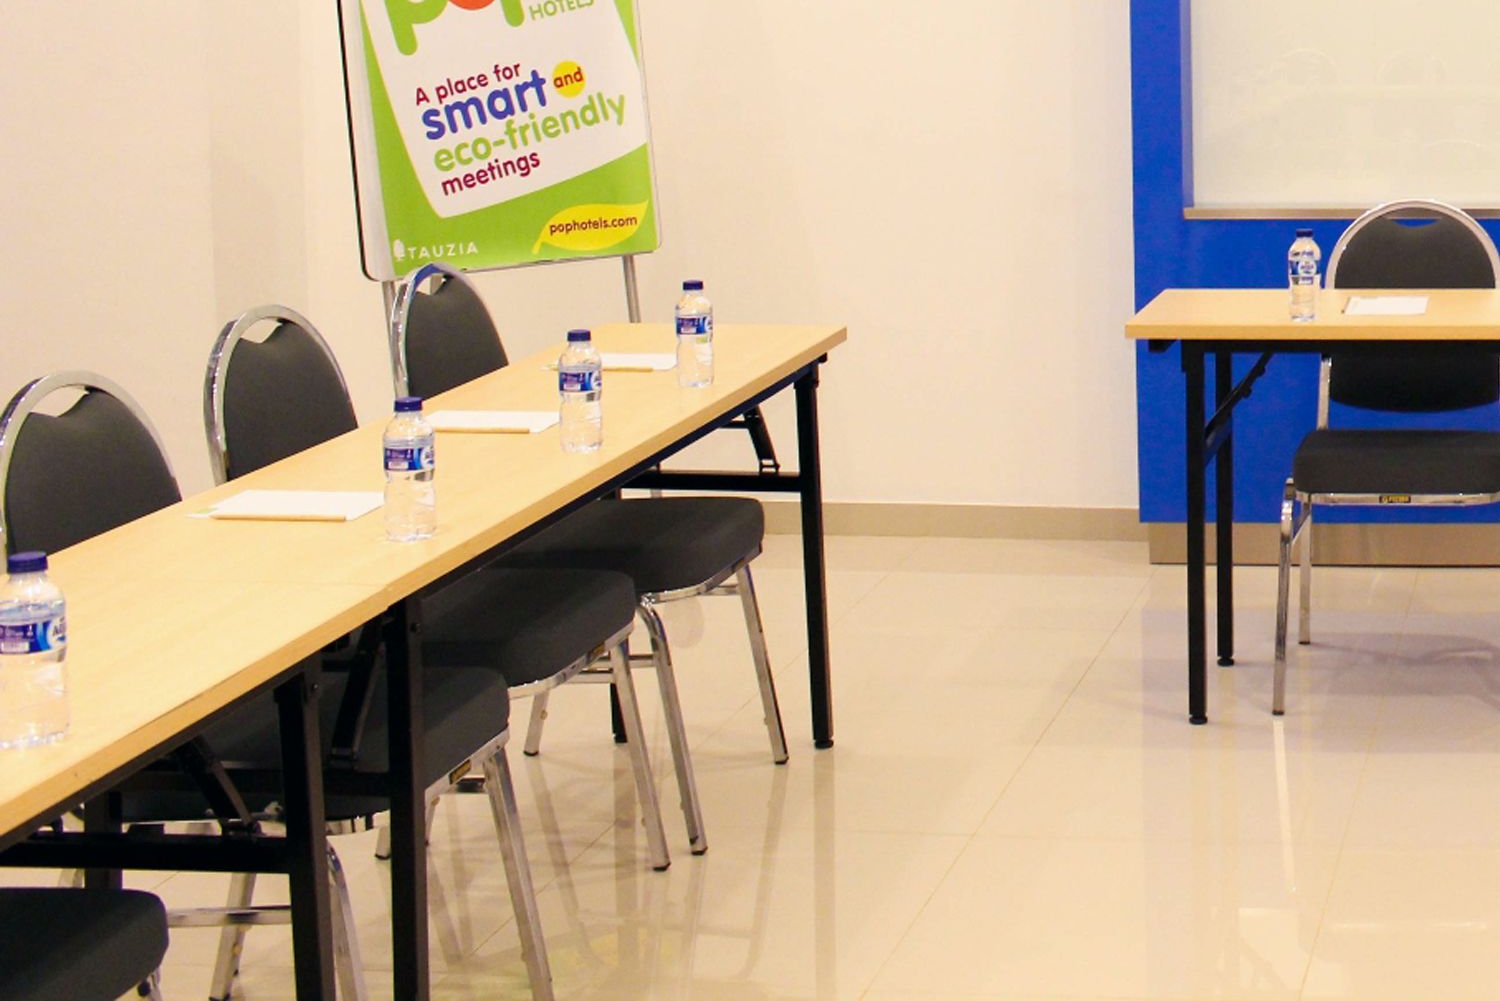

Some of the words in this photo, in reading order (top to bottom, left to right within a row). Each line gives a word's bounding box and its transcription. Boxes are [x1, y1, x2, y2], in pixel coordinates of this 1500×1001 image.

[415, 87, 430, 106] A
[435, 73, 489, 104] place
[493, 63, 521, 82] for
[422, 69, 546, 140] smart
[553, 66, 584, 89] and
[434, 92, 625, 172] eco-friendly
[441, 152, 540, 196] meetings
[550, 216, 637, 236] pophotels.com
[408, 241, 478, 260] TAUZIA
